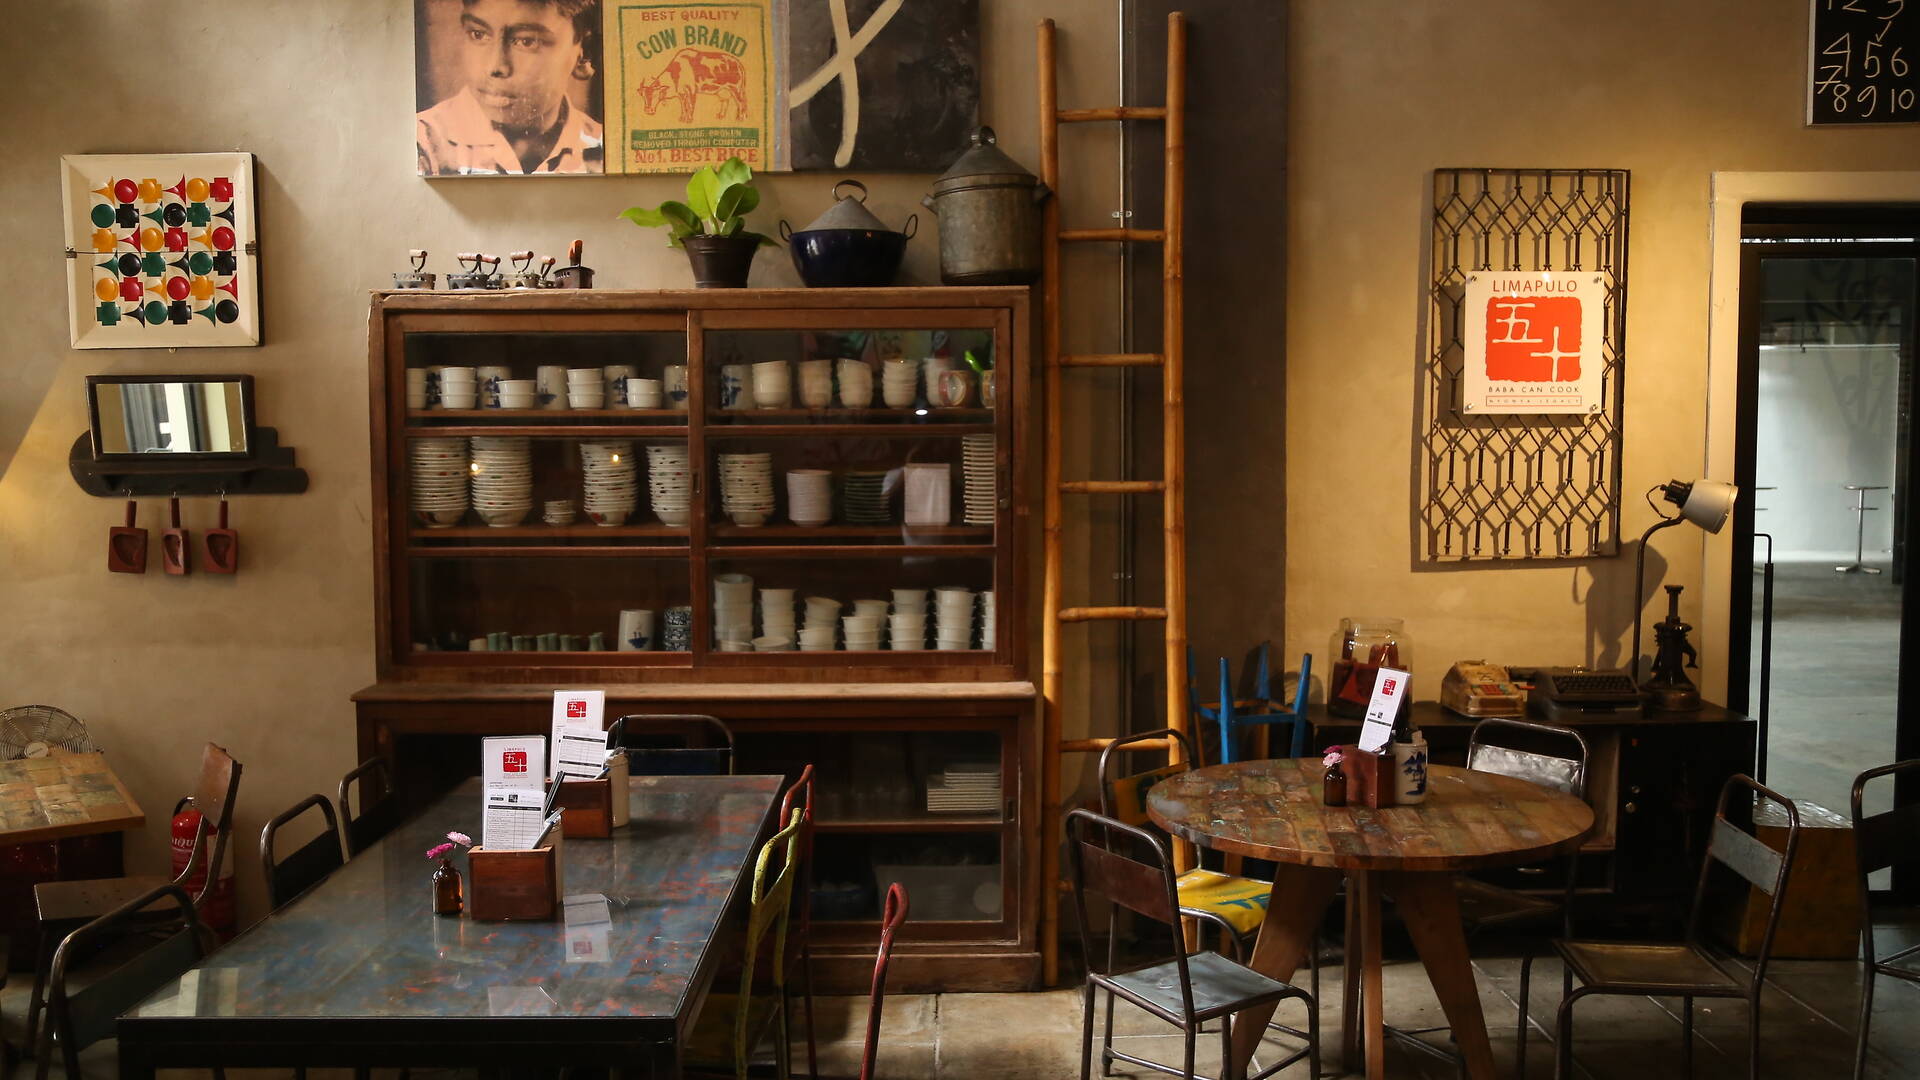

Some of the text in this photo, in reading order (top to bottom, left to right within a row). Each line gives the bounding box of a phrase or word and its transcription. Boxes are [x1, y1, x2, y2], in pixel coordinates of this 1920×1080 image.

[641, 10, 740, 22] BEST QUALITY
[636, 25, 748, 60] COW BRAND
[1822, 33, 1908, 78] 4 5 6
[1815, 65, 1915, 117] 7 8 9 10
[671, 148, 713, 163] BEST
[717, 148, 758, 163] RICE
[1492, 279, 1578, 293] LIMAPULO
